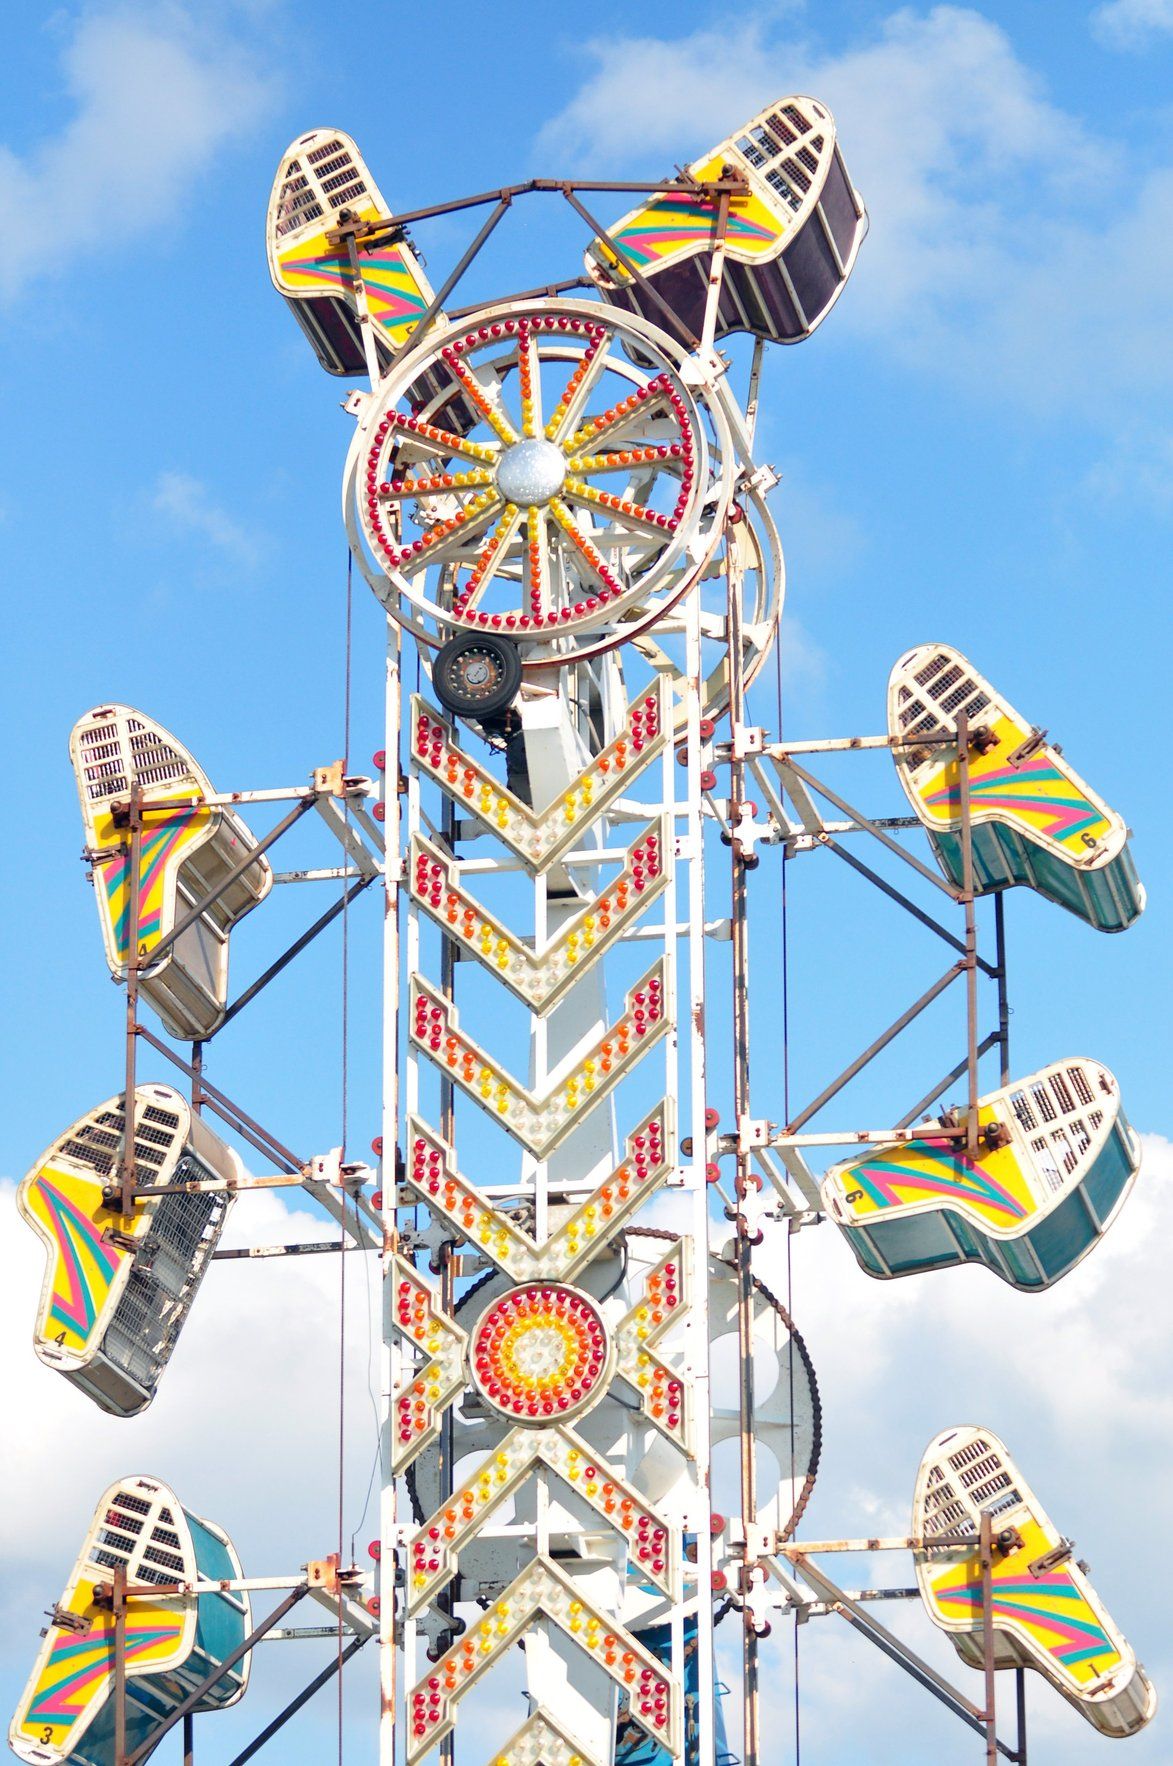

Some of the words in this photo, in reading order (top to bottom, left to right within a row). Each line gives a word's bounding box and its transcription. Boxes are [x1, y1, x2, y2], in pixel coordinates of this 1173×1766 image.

[1081, 832, 1097, 848] 6
[55, 1331, 66, 1347] 4
[1088, 1663, 1100, 1678] 1
[40, 1726, 53, 1745] 3
